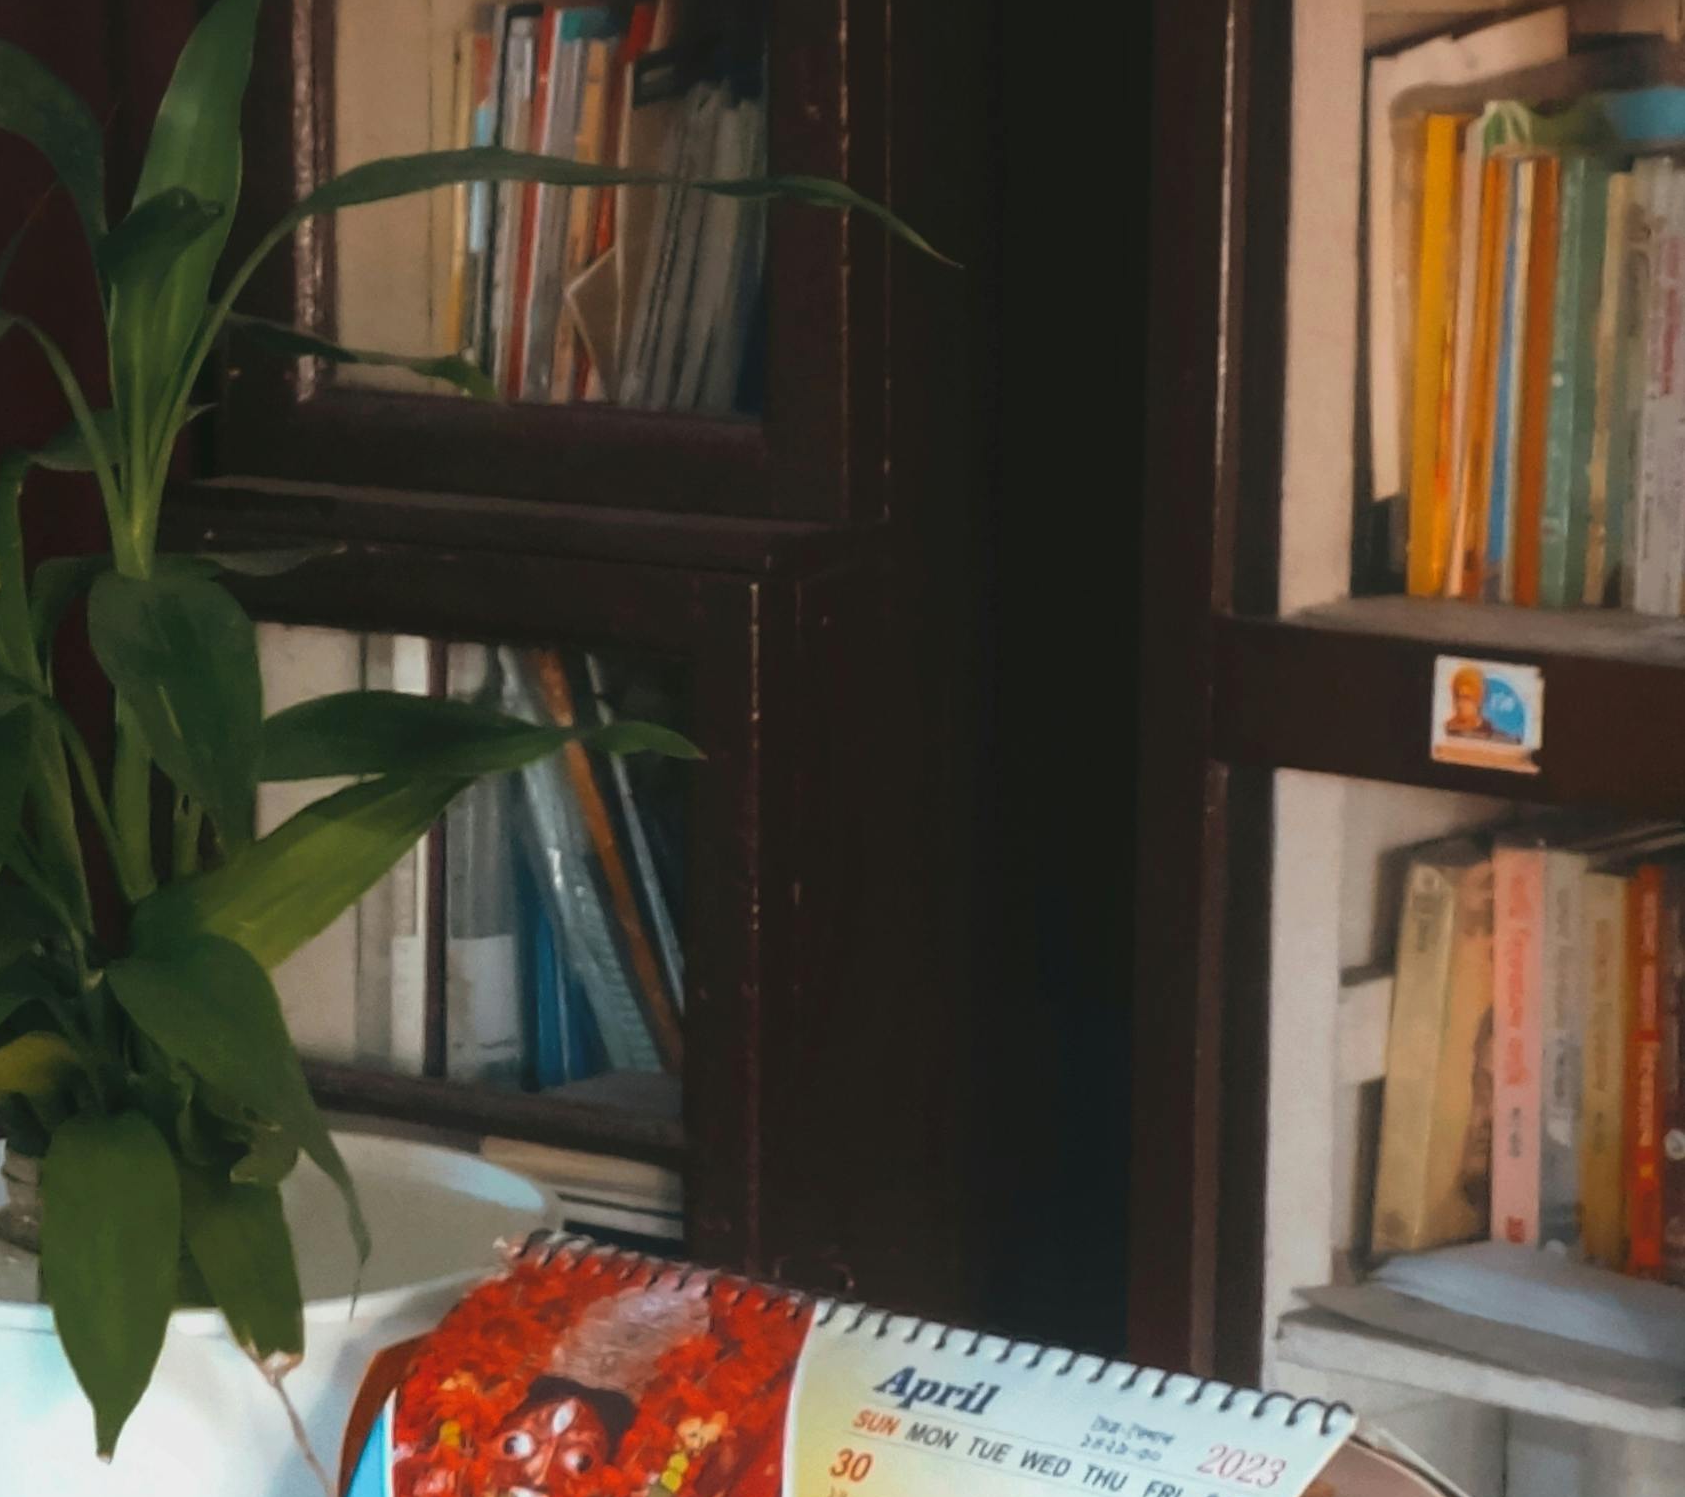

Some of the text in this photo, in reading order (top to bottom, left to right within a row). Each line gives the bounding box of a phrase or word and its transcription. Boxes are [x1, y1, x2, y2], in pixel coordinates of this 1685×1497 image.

[874, 1365, 1000, 1417] April
[829, 1448, 873, 1483] 30
[852, 1409, 901, 1436] SUN
[904, 1421, 958, 1451] MON
[966, 1435, 1011, 1465] TUE
[1019, 1447, 1072, 1479] WED
[1082, 1463, 1130, 1492] THU
[1196, 1443, 1286, 1489] 2023
